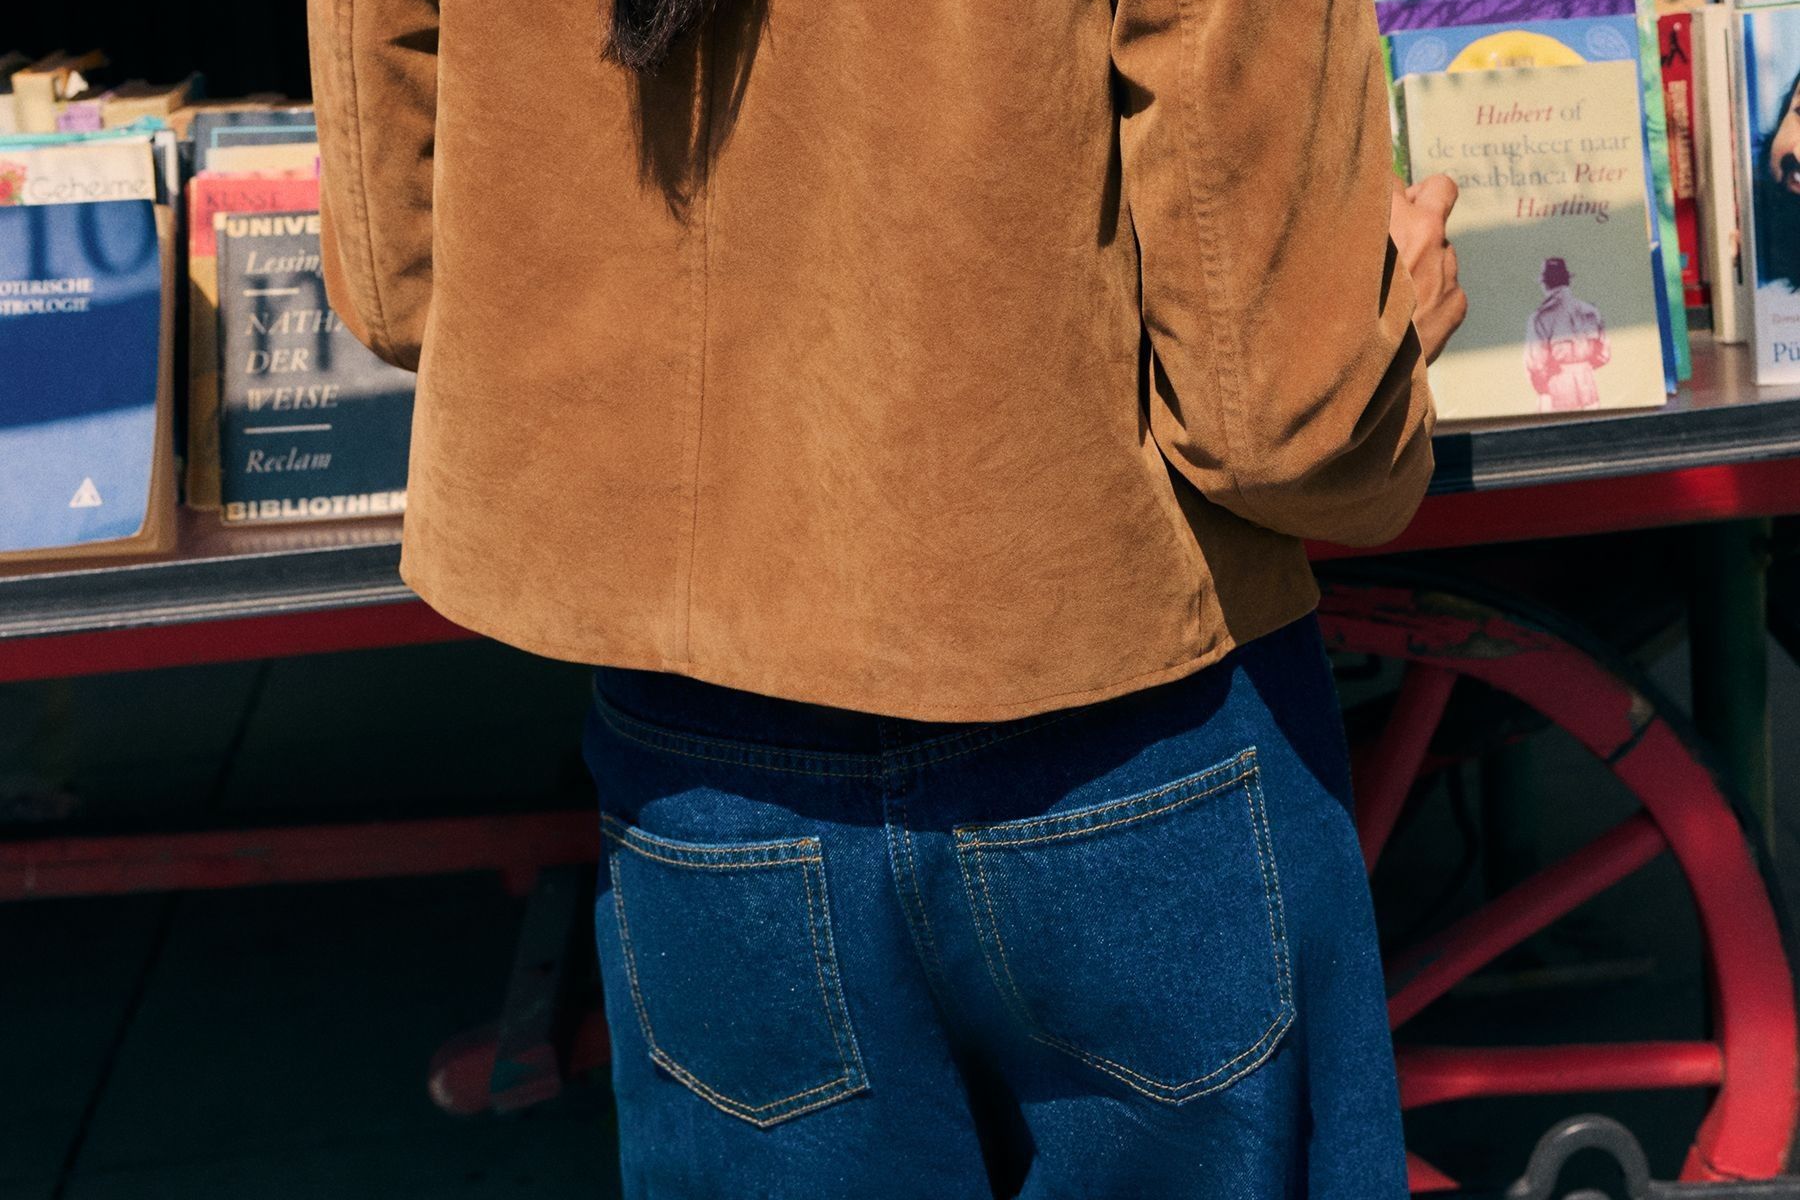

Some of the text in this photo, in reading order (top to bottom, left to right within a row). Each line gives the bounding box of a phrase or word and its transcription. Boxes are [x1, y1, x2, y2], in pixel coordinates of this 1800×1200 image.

[1476, 102, 1582, 126] Hubert of
[1428, 134, 1632, 162] de terugkeer naar
[1573, 162, 1629, 184] Peter
[30, 176, 148, 201] Geheime
[227, 215, 321, 238] UNIVE
[246, 346, 310, 375] DER
[247, 384, 340, 411] WEISE
[245, 447, 332, 474] Reclam
